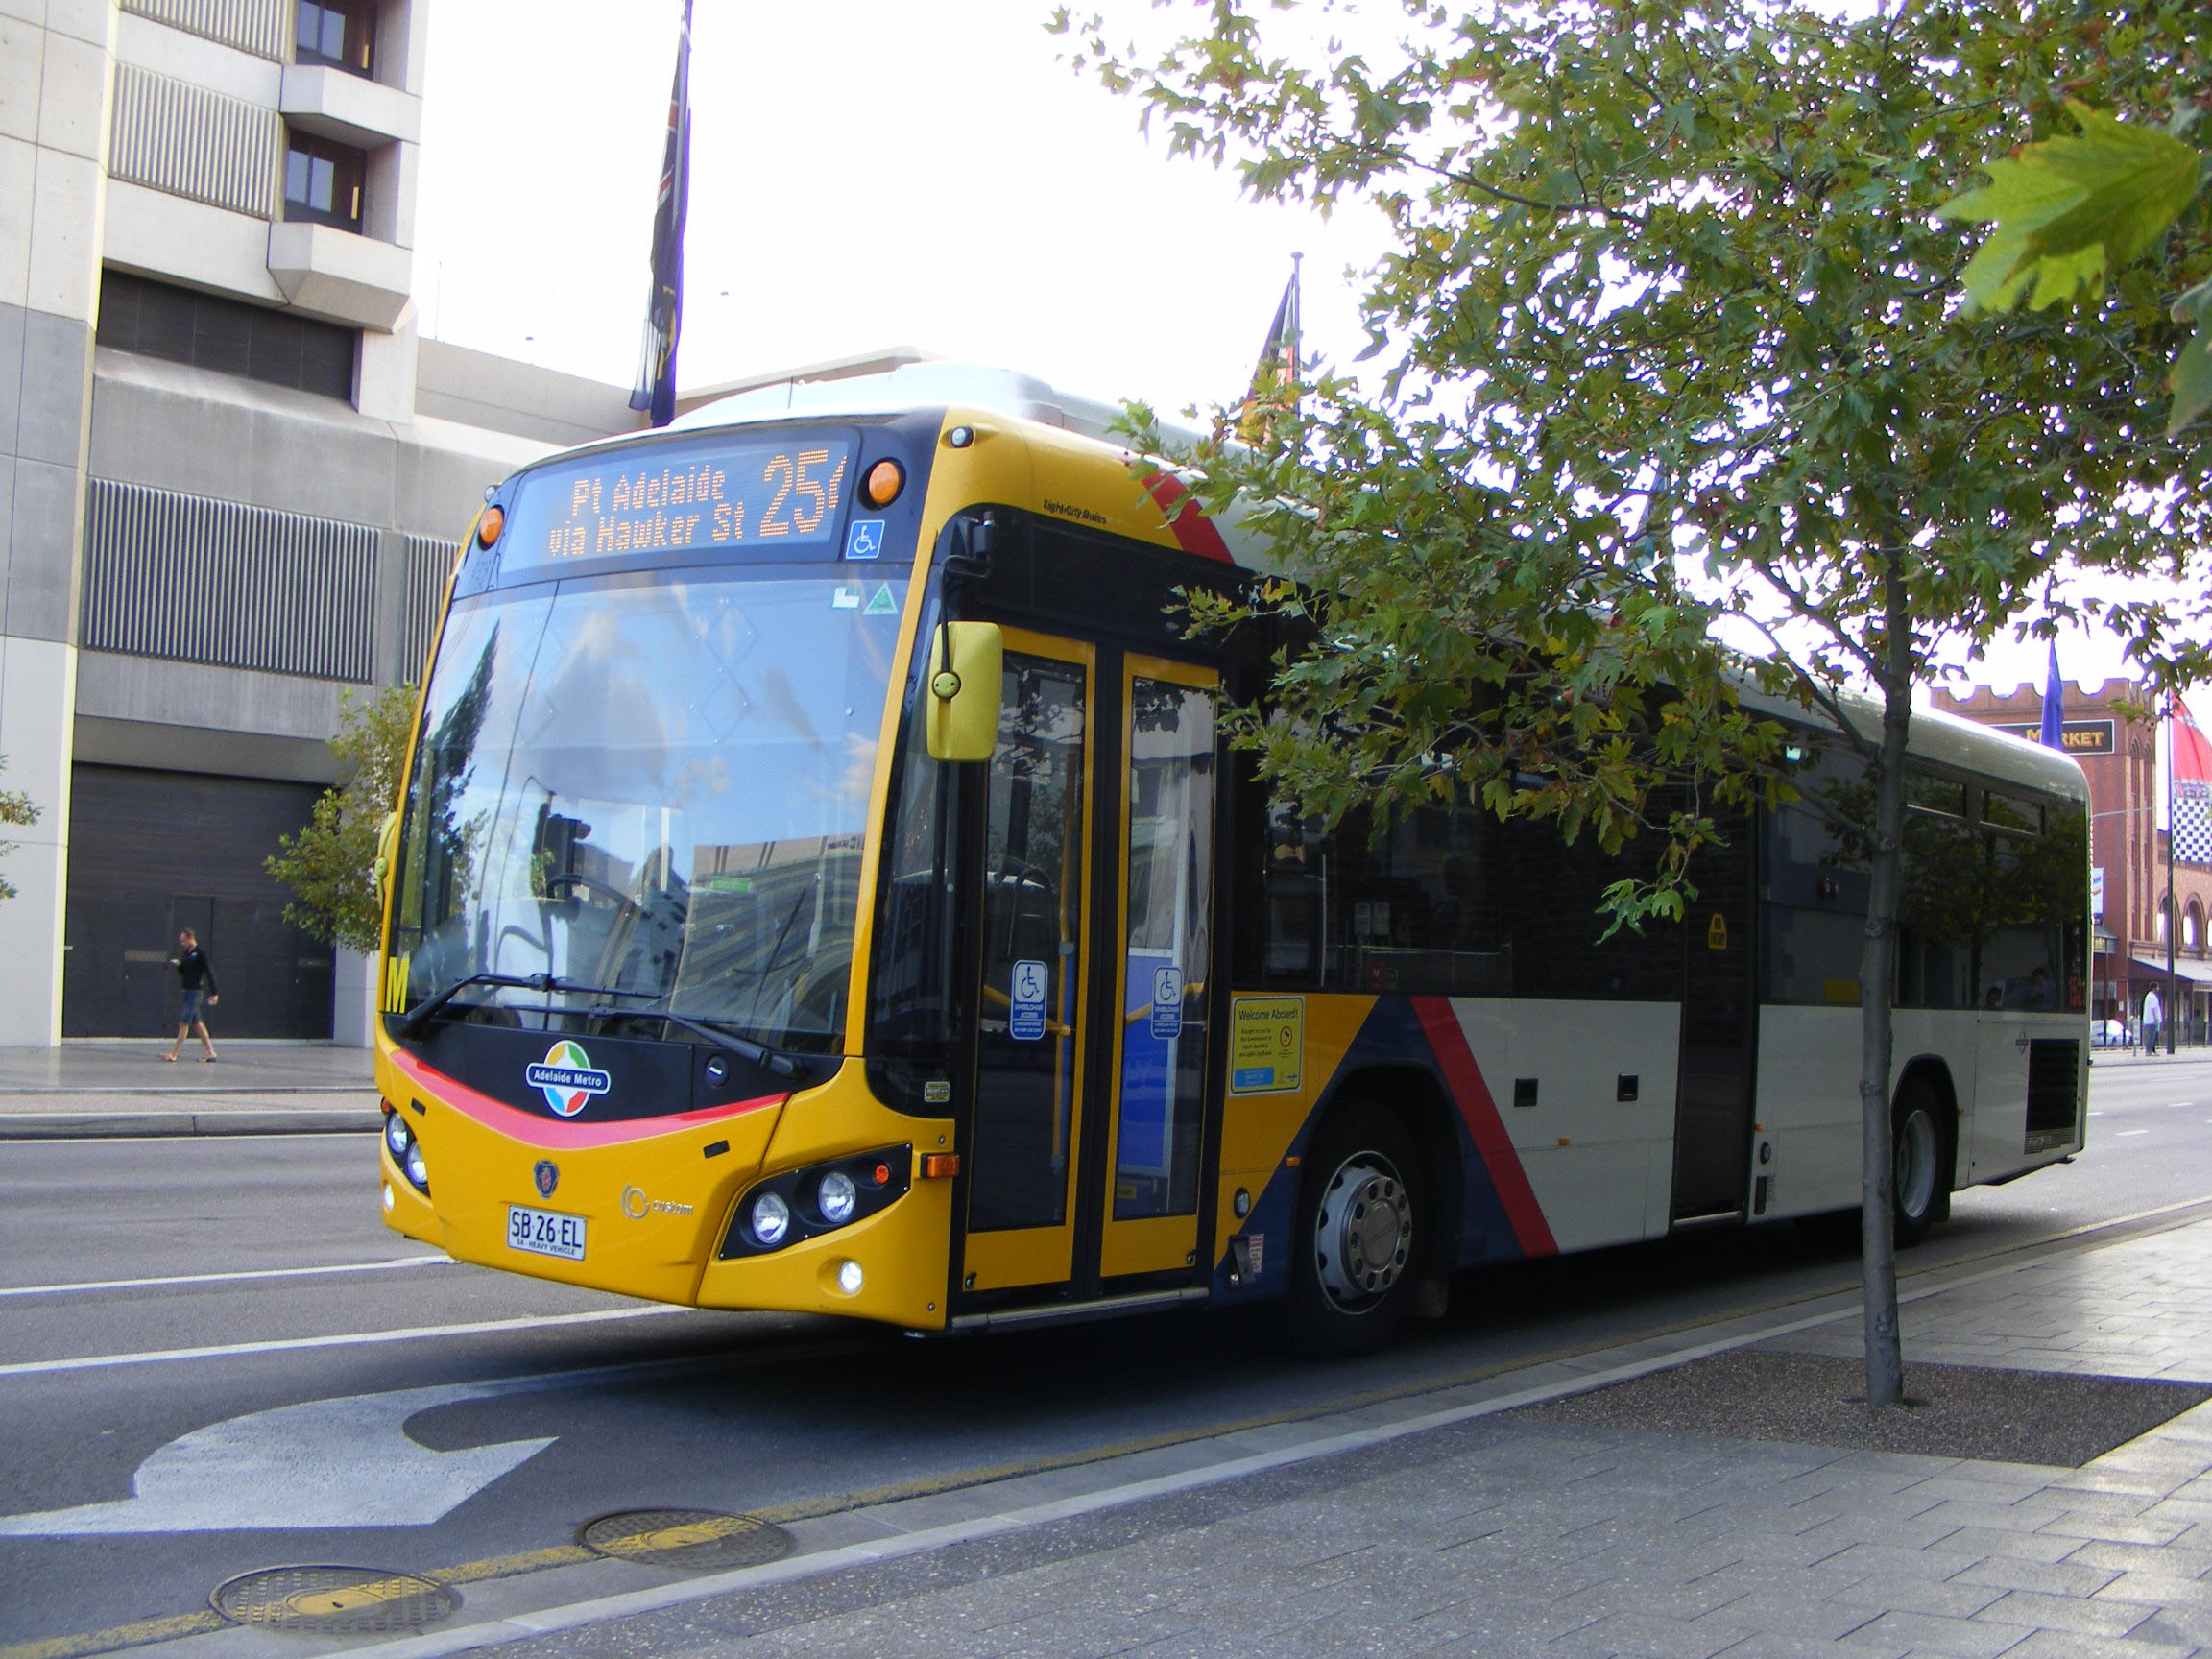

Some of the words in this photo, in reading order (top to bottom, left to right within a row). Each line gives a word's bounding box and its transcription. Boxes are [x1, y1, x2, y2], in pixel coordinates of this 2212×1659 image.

[572, 479, 601, 517] Pt
[613, 464, 726, 510] Adelaide
[548, 520, 585, 557] via
[595, 511, 701, 553] Hawker
[711, 501, 745, 541] St
[2026, 728, 2104, 747] MRKET
[1239, 1010, 1269, 1021] Welcome
[1272, 1007, 1298, 1020] Aboard!
[534, 1069, 571, 1084] Adelaide
[574, 1073, 602, 1088] Metro
[528, 1239, 547, 1251] HEAVY
[549, 1244, 575, 1256] VEHICLE
